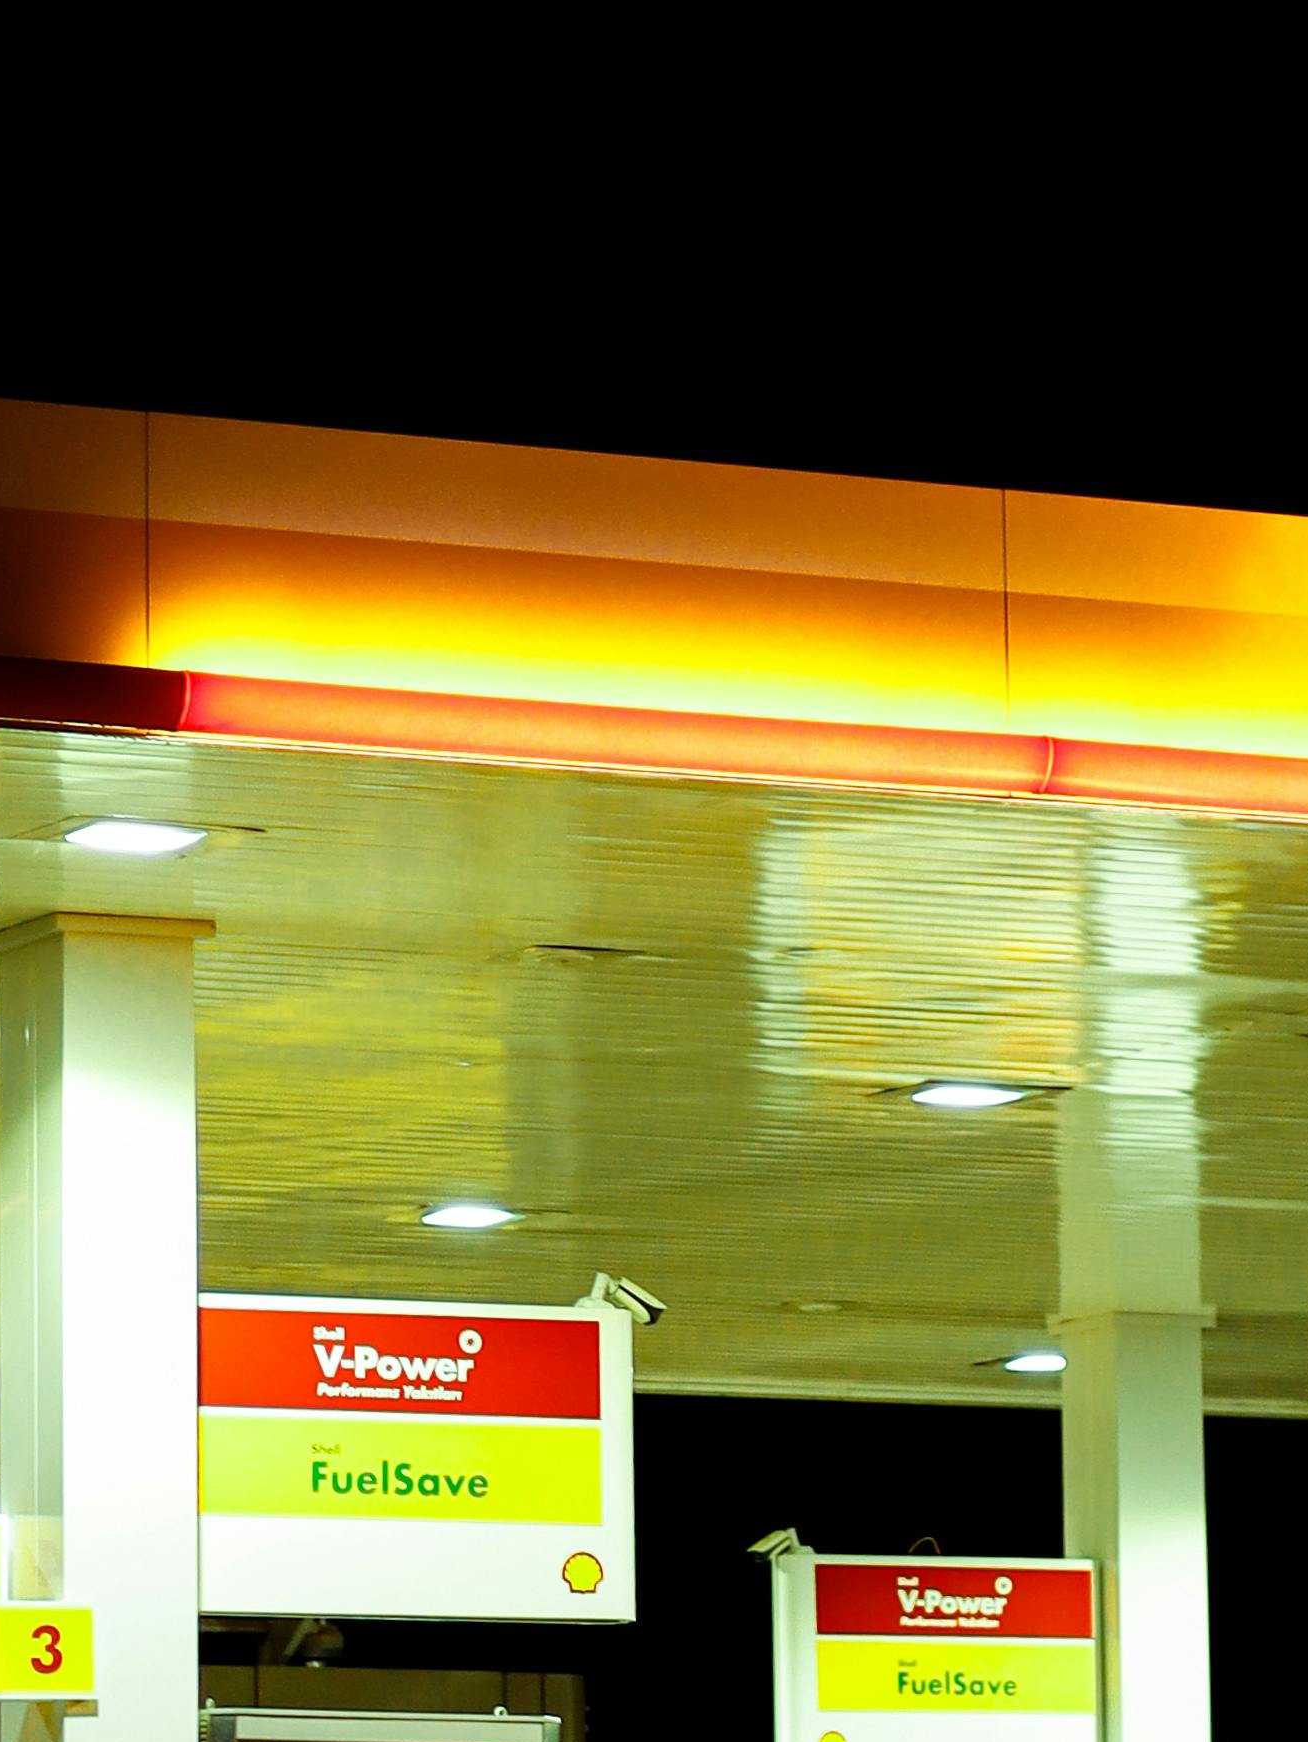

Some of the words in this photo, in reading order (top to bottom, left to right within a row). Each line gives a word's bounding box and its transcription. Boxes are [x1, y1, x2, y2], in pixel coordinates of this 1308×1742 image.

[312, 1326, 346, 1341] Shell
[313, 1343, 475, 1383] V-Power
[311, 1443, 340, 1455] Shell
[311, 1460, 489, 1498] FuelSave
[897, 1589, 1008, 1615] V-Power
[31, 1624, 63, 1674] 3
[898, 1670, 1017, 1696] FuelSave
